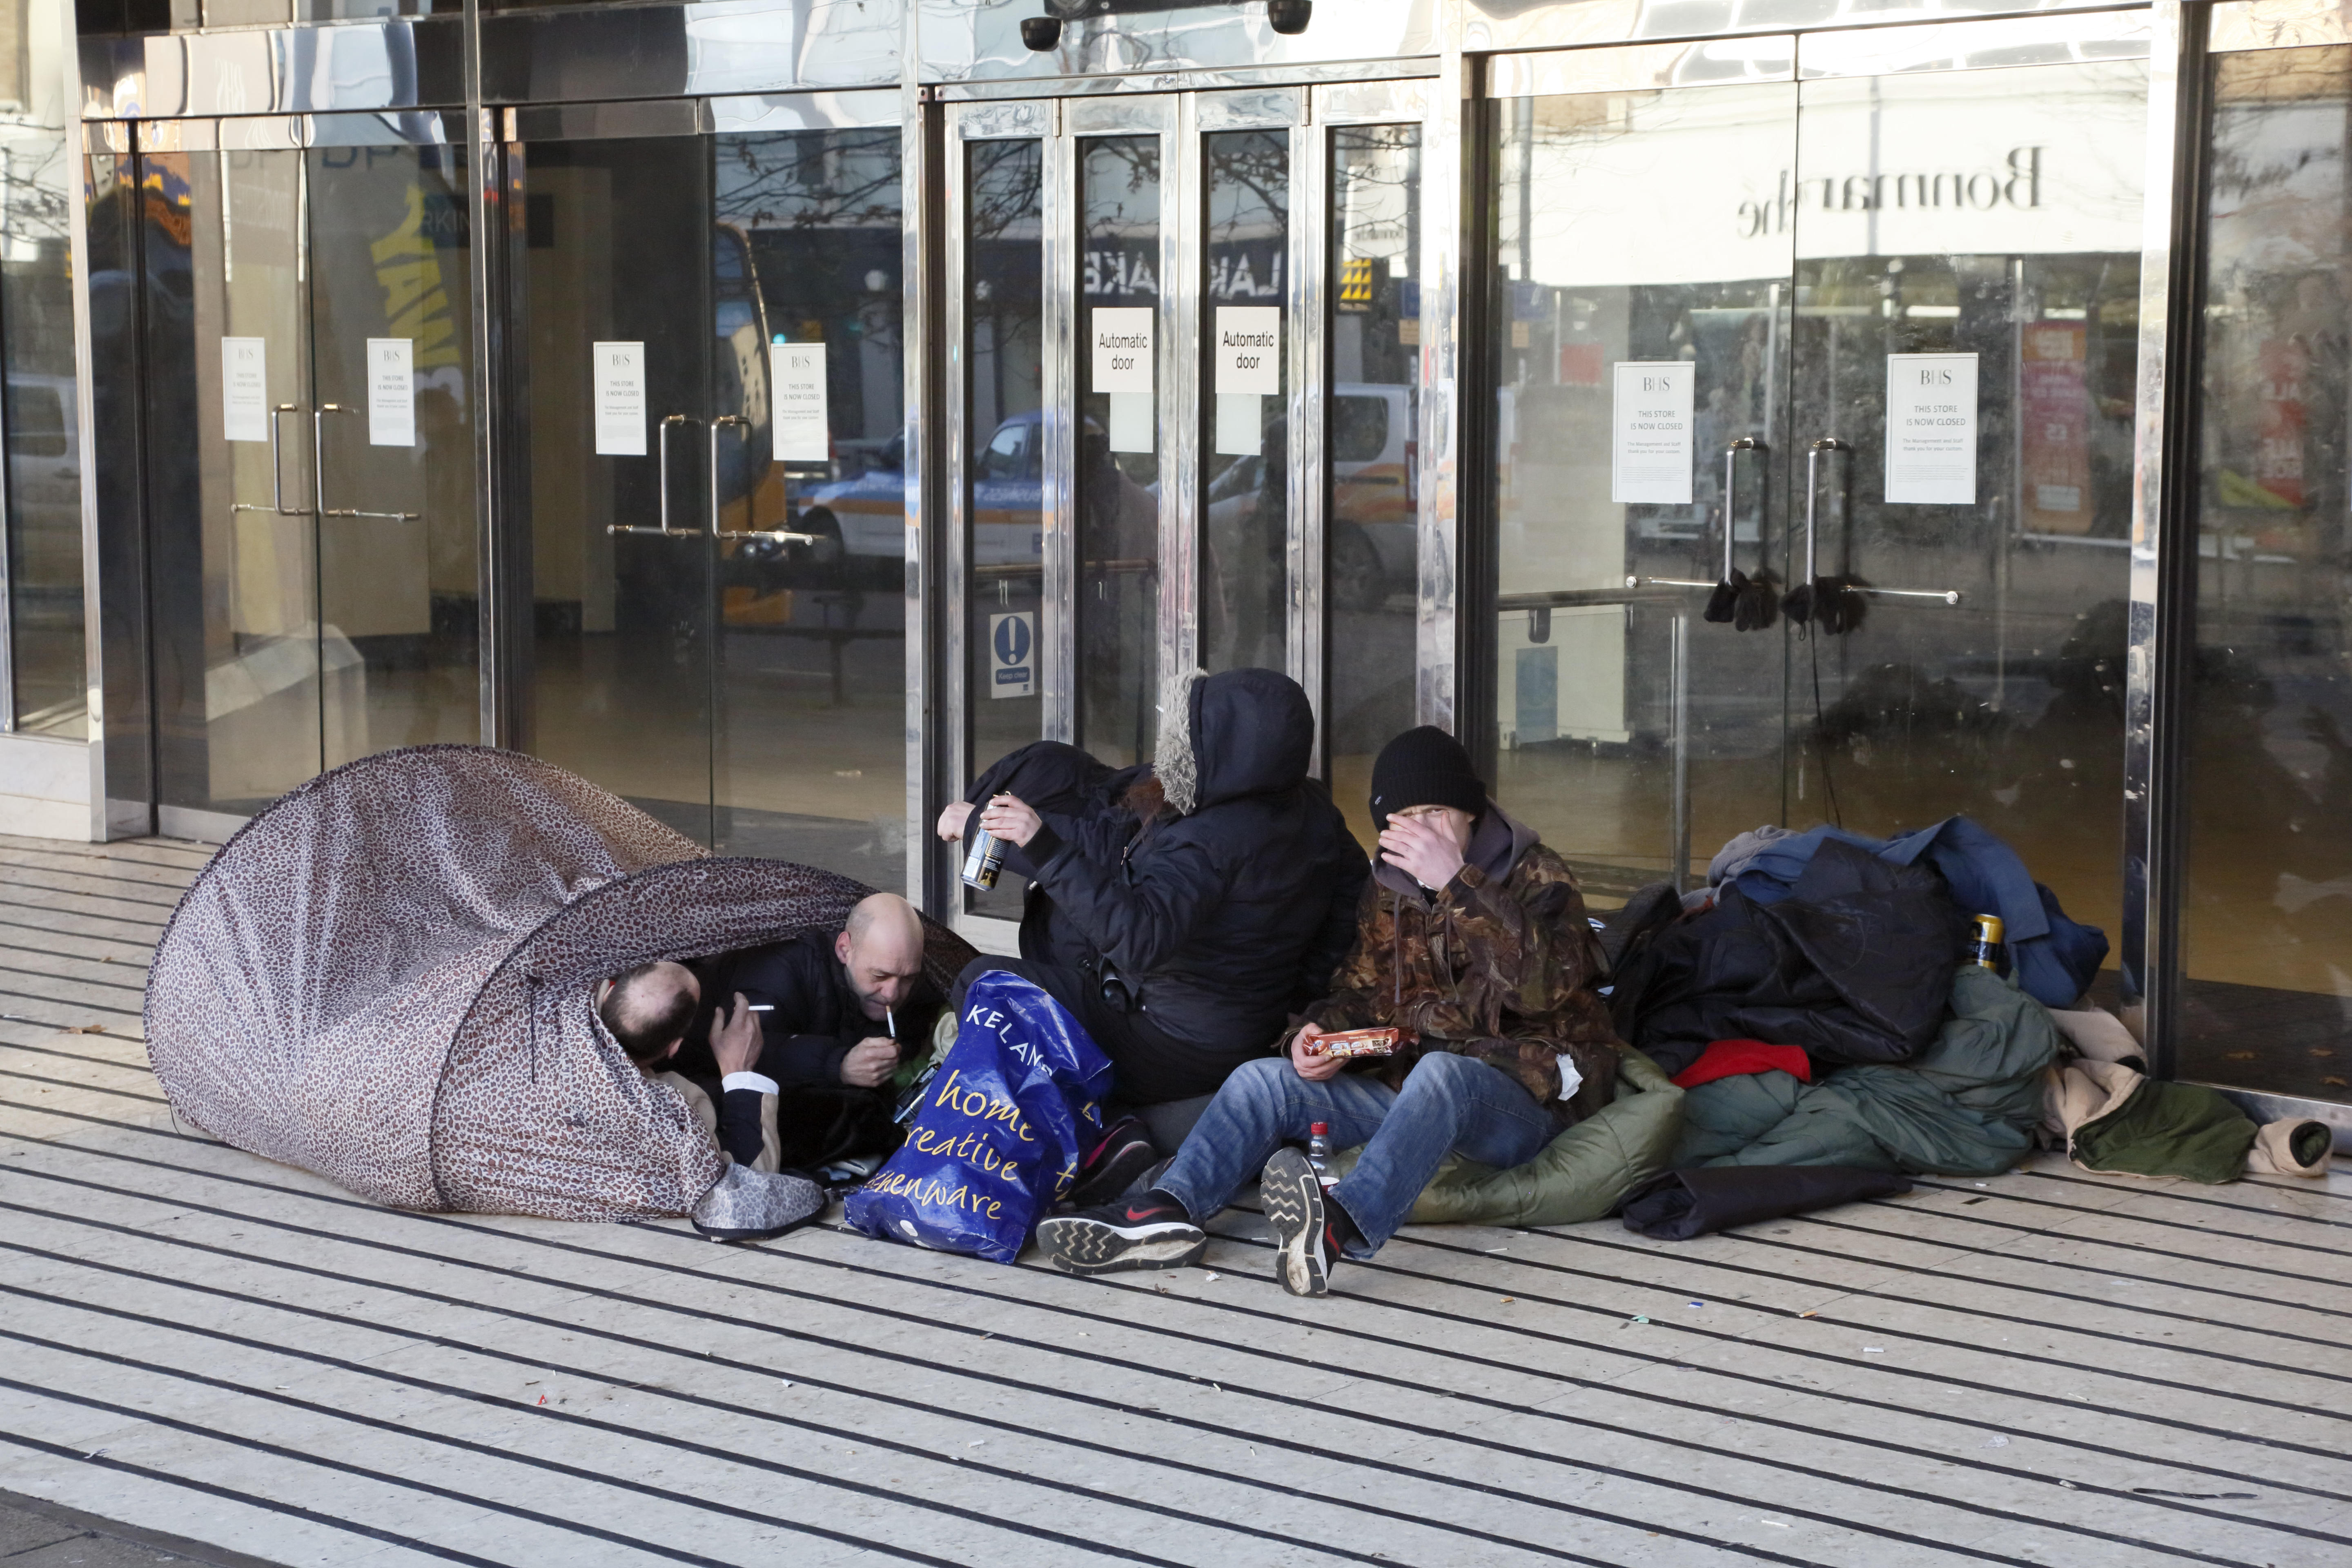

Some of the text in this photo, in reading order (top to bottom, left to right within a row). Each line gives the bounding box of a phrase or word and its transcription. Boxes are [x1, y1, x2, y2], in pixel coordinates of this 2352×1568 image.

[1099, 333, 1147, 348] Automatic
[1223, 331, 1274, 347] Automatic
[384, 350, 399, 361] BHS
[612, 354, 630, 365] BHS
[792, 356, 810, 368] BHS
[1112, 354, 1134, 370] door
[1236, 353, 1260, 369] door
[1644, 377, 1670, 391] BHS
[1921, 370, 1951, 385] BHS
[935, 1069, 1034, 1141] home
